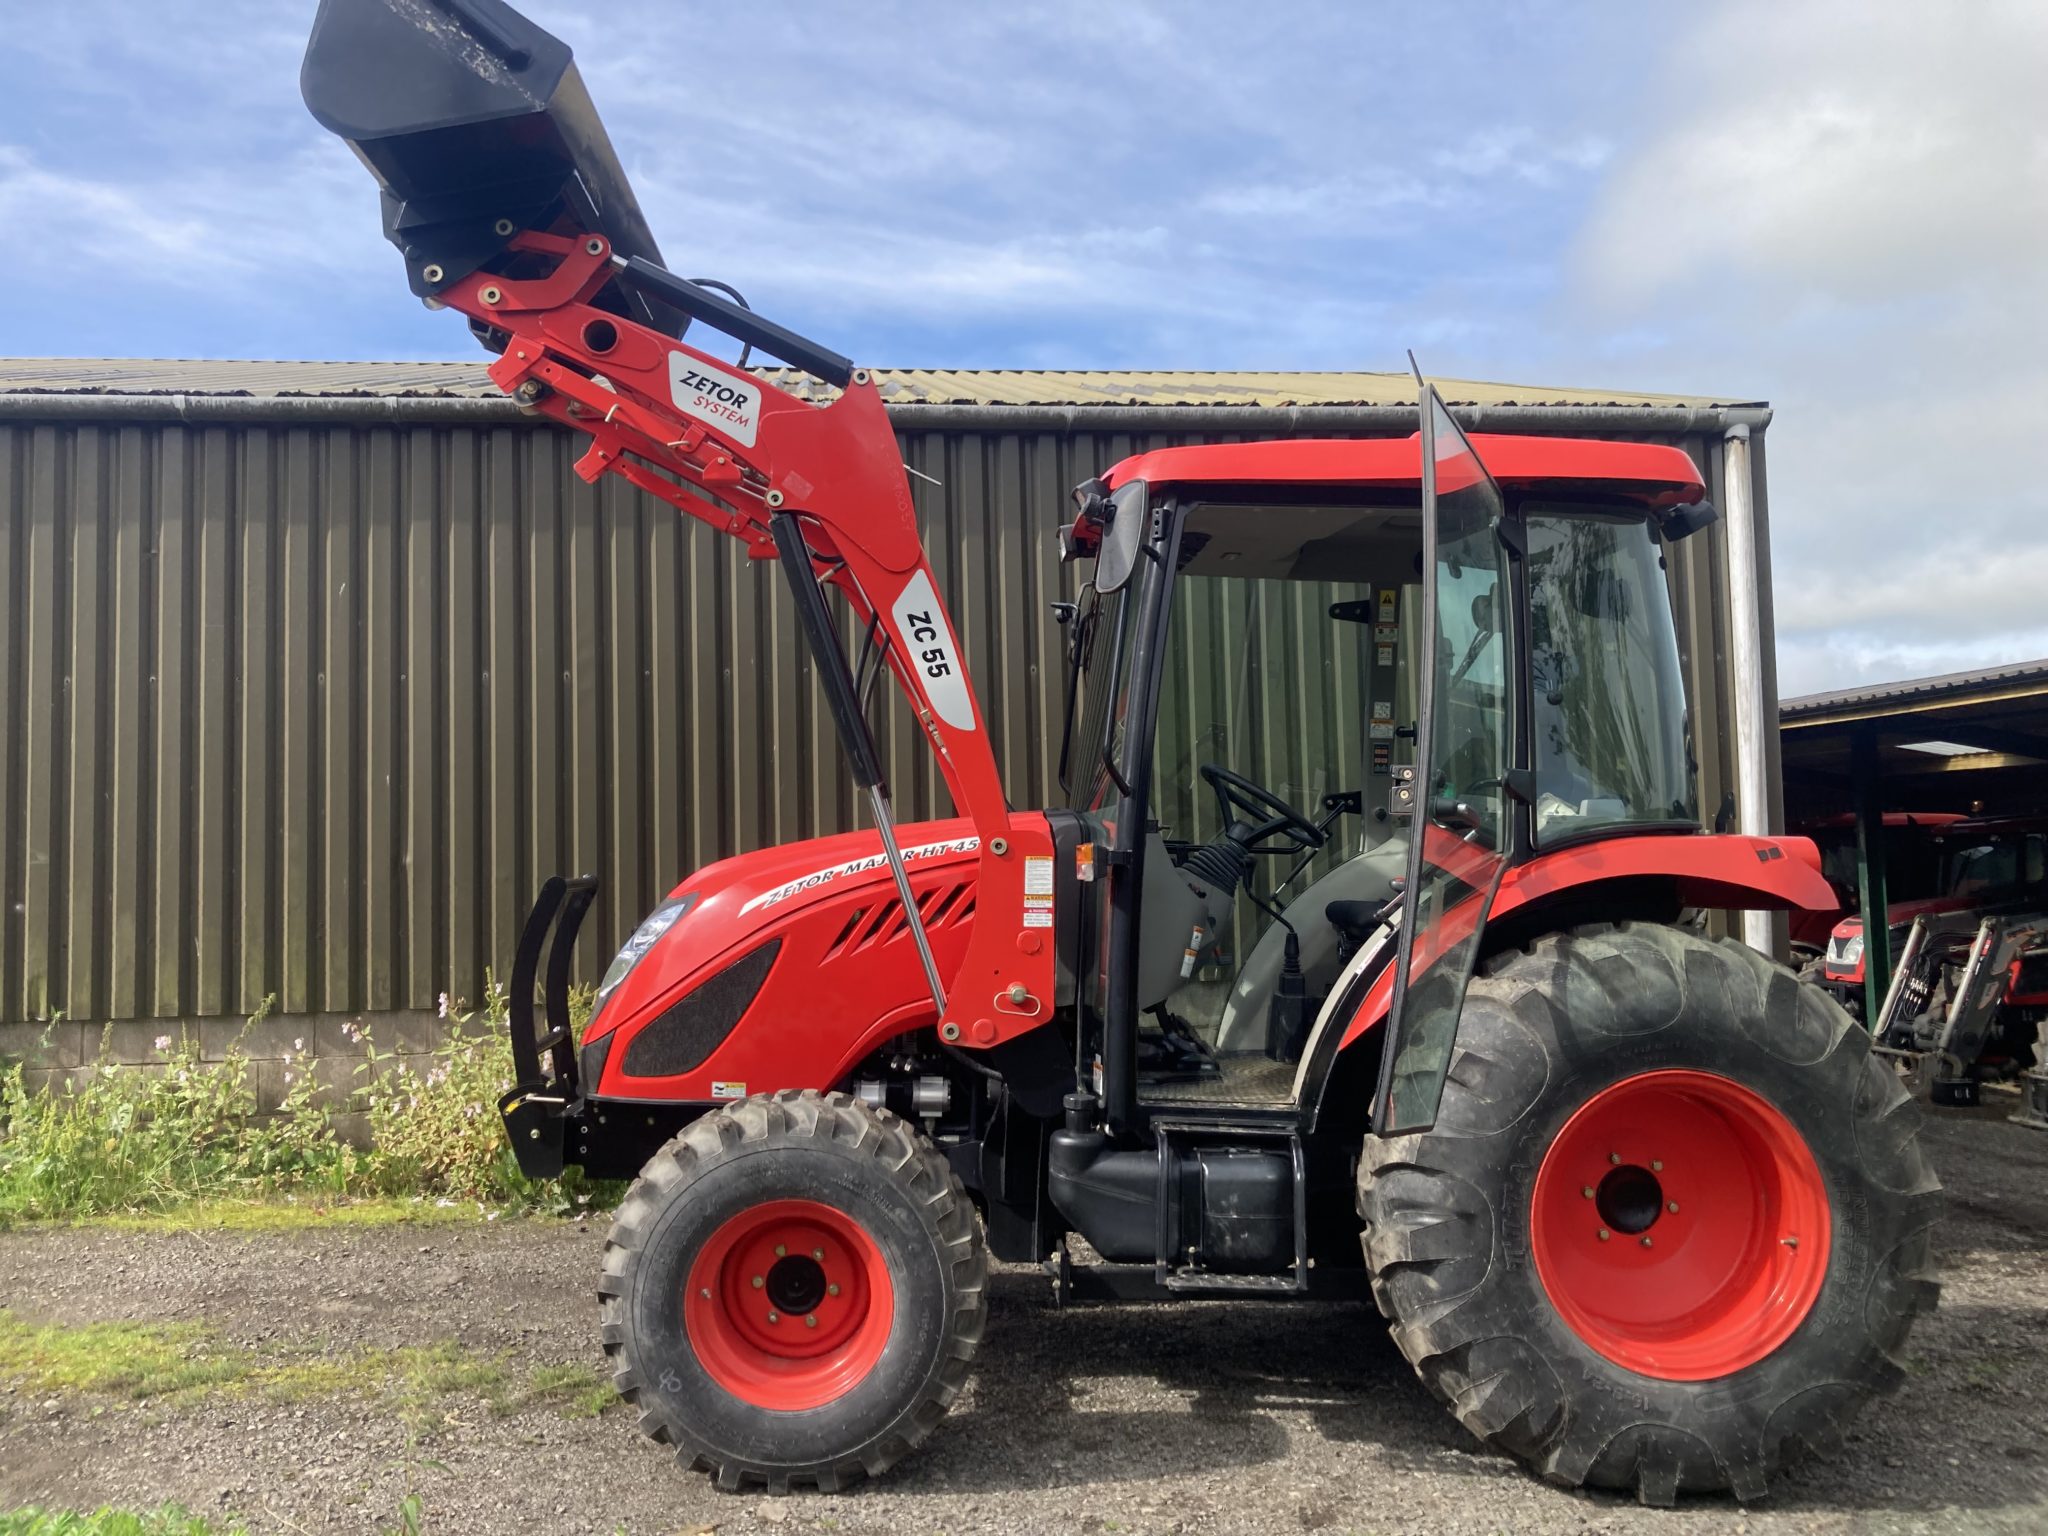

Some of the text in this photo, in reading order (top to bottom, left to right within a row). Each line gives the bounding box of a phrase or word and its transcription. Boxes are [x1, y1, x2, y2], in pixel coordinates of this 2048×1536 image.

[679, 370, 748, 409] ZETOR
[693, 396, 750, 427] SYSTEM
[907, 611, 951, 678] ZC 55
[767, 839, 978, 906] ZETOR MAJR HT 45
